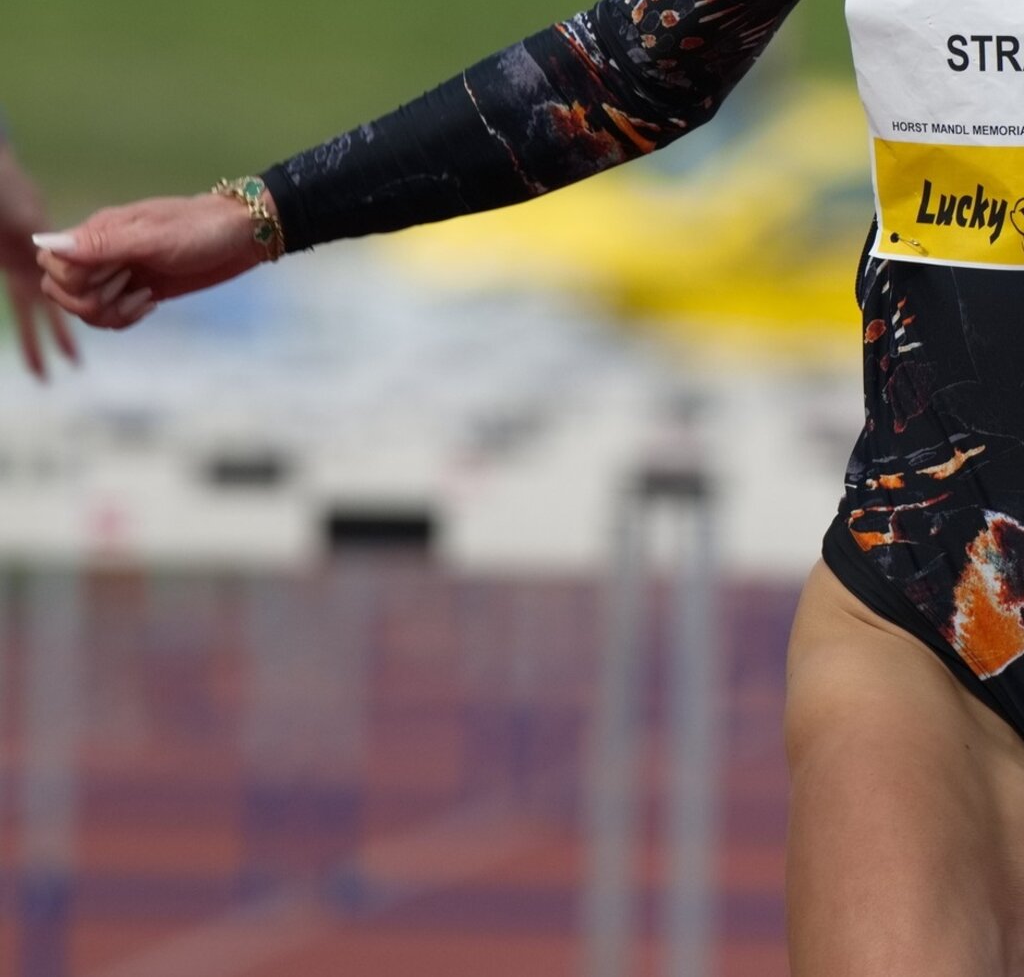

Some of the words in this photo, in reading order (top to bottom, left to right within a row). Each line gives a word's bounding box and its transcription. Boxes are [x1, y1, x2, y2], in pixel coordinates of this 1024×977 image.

[892, 121, 928, 133] HORST
[931, 123, 970, 135] MANDL
[916, 179, 1008, 244] Lucky
